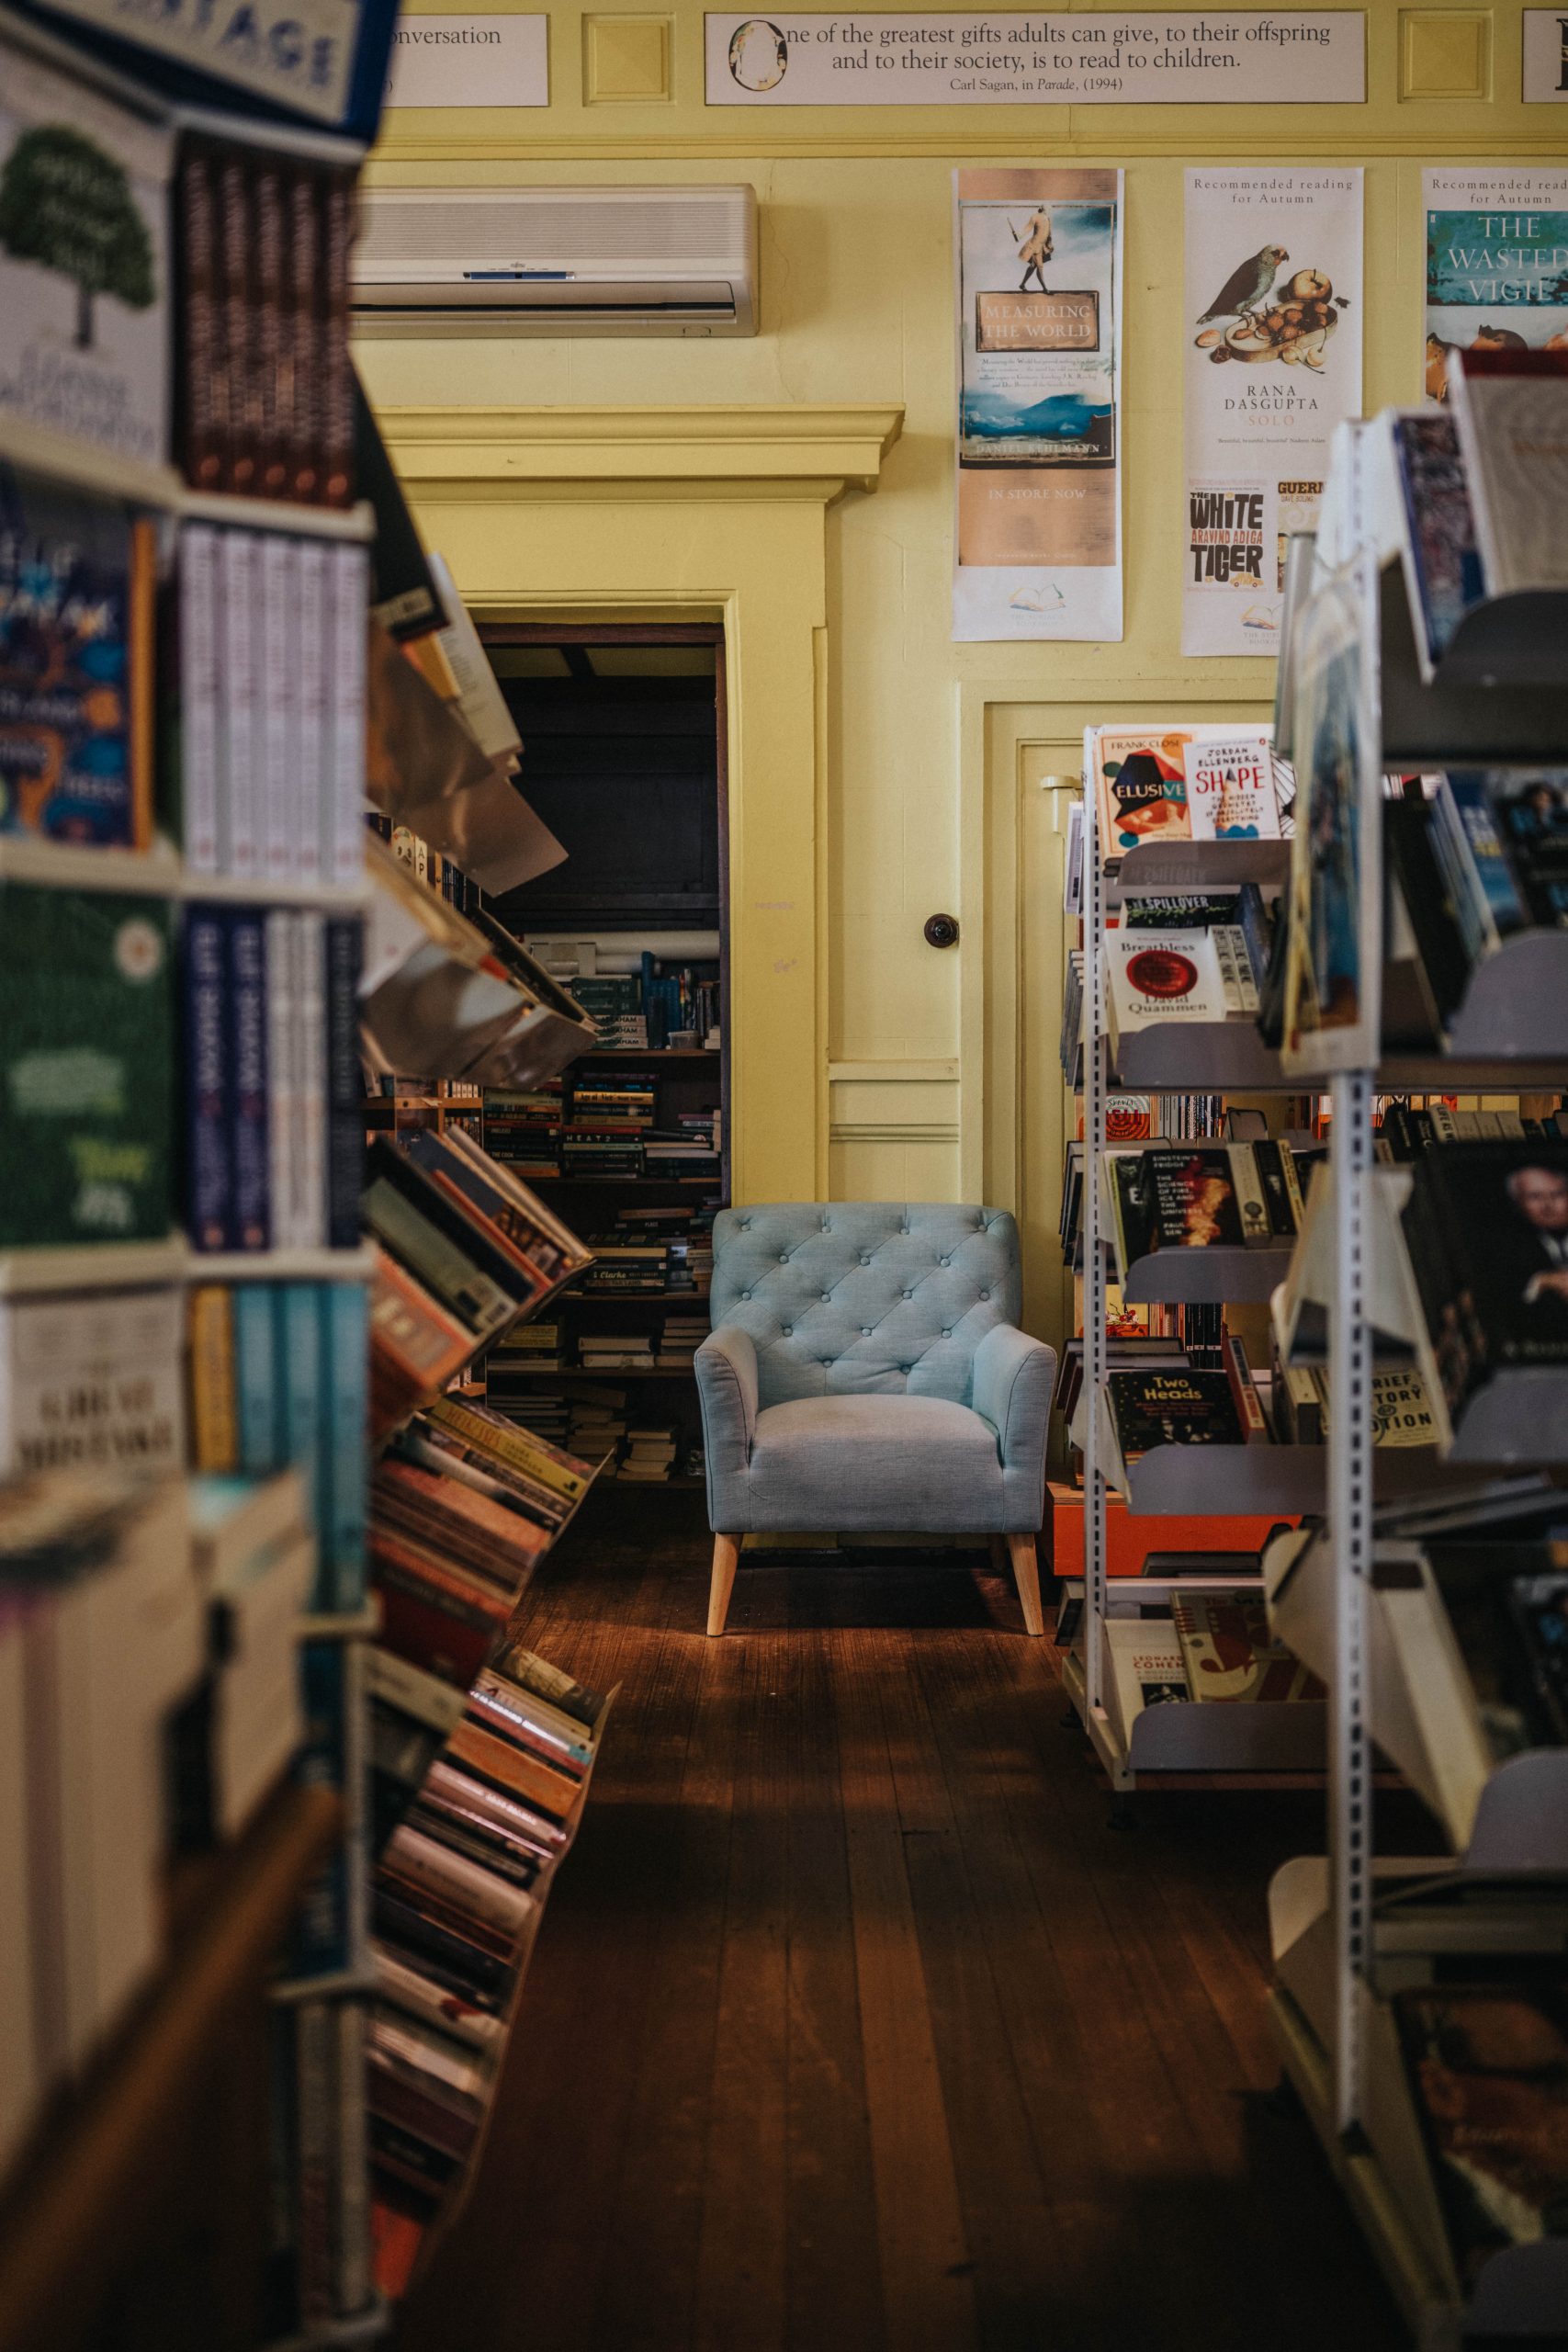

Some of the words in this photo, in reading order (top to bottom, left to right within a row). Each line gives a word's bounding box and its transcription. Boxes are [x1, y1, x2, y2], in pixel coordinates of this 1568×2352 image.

[817, 23, 837, 42] of
[842, 23, 874, 42] the
[880, 25, 954, 47] greatest
[961, 22, 1001, 47] gifts
[1008, 22, 1066, 42] adults
[1072, 27, 1106, 42] can
[1112, 25, 1158, 46] give,
[1166, 26, 1185, 42] to
[1192, 21, 1239, 41] their
[1245, 20, 1331, 45] offspring
[832, 49, 868, 69] and
[874, 52, 895, 69] to
[901, 49, 948, 69] their
[953, 50, 1025, 73] society,
[1032, 51, 1046, 68] is
[1053, 51, 1072, 68] to
[1079, 48, 1121, 69] read
[1127, 51, 1147, 68] to
[1153, 47, 1241, 68] children.
[950, 78, 976, 90] Carl
[979, 78, 1019, 93] Sagan,
[1021, 79, 1033, 90] in
[1037, 78, 1078, 91] Parade,
[1083, 77, 1122, 91] (1994)
[1194, 178, 1293, 189] Recommended
[1300, 178, 1353, 191] reading
[1432, 179, 1531, 189] Recommended
[1233, 193, 1252, 204] for
[1258, 193, 1314, 204] Autumn
[1471, 194, 1490, 204] for
[1497, 194, 1552, 204] Autumn
[1478, 217, 1540, 238] THE
[1448, 248, 1568, 269] WASTED
[1469, 279, 1551, 300] VIGIL
[985, 304, 1091, 319] MEASURING
[985, 323, 1021, 339] THE
[1026, 323, 1092, 338] WORLD
[1247, 385, 1297, 397] RANA
[1224, 398, 1319, 410] DASGUPTA
[1248, 414, 1295, 426] SOLO
[976, 444, 1025, 454] DANIEL
[988, 489, 1004, 500] IN
[1008, 489, 1051, 500] STORE
[1055, 488, 1088, 500] NOW
[1191, 529, 1231, 545] ARAVIND
[1233, 529, 1263, 545] ADIGA
[1190, 544, 1264, 582] TIGER
[1111, 740, 1146, 750] FRANK
[1207, 747, 1248, 758] JORDAN
[1198, 755, 1260, 768] ELLENBERG
[1195, 765, 1266, 795] SHAPE
[1116, 783, 1185, 799] ELUSIVE
[1145, 896, 1210, 910] SPILLOVER
[1120, 942, 1196, 952] Breathless
[1144, 993, 1190, 1004] David
[1128, 1002, 1208, 1014] Quammen
[1152, 1376, 1190, 1388] Two
[1145, 1388, 1203, 1400] Heads
[1134, 1661, 1186, 1669] COHEN
